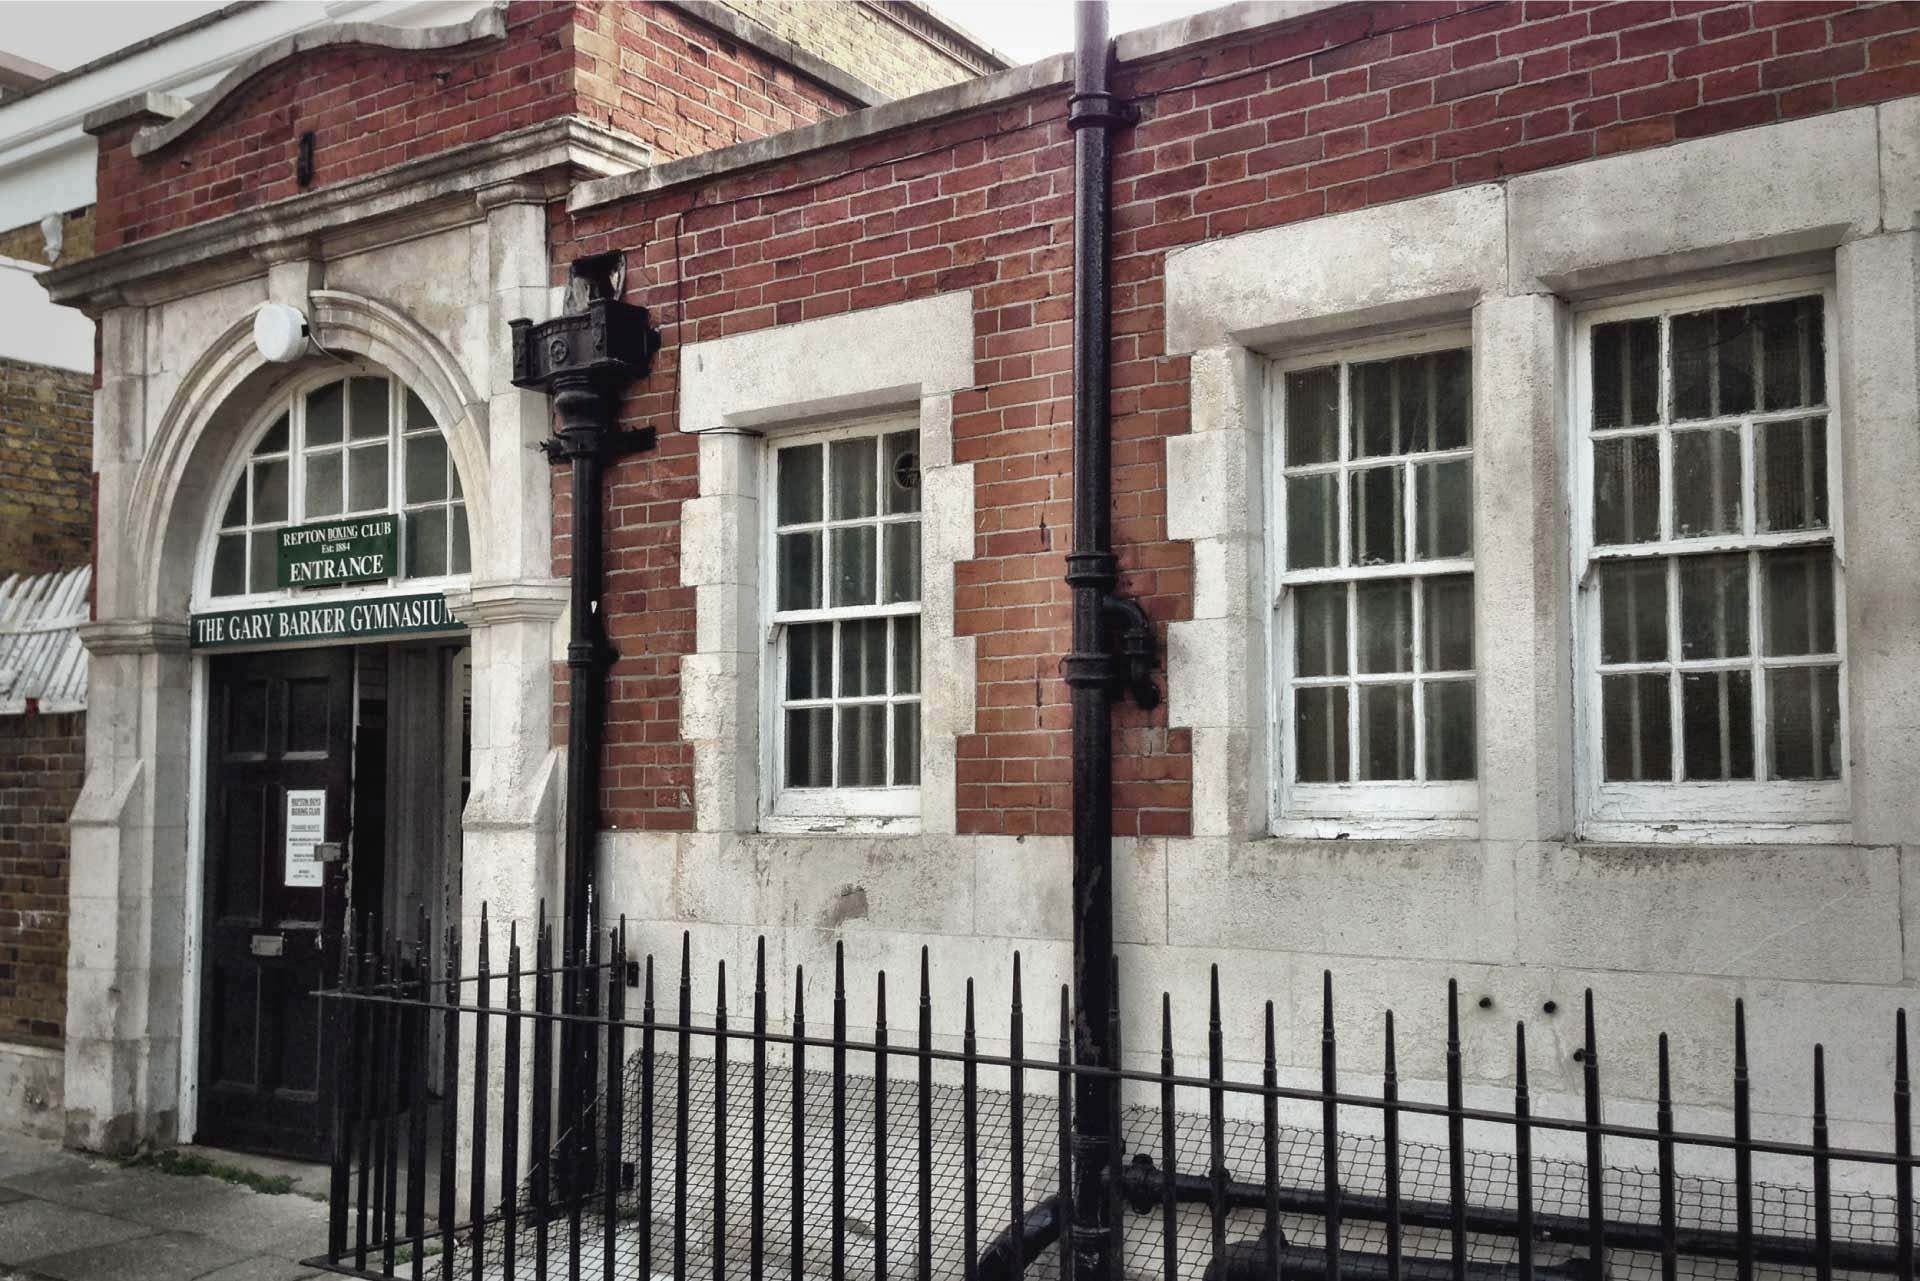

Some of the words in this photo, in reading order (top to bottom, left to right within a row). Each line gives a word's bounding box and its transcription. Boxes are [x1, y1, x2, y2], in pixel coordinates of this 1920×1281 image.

[283, 529, 326, 547] REPTON
[327, 525, 358, 541] BOXING
[361, 521, 392, 538] CLUB
[335, 542, 351, 553] 1884
[289, 554, 384, 582] ENTRANCE
[198, 617, 225, 643] THE
[229, 612, 274, 641] GARY
[279, 607, 346, 637] BARKER
